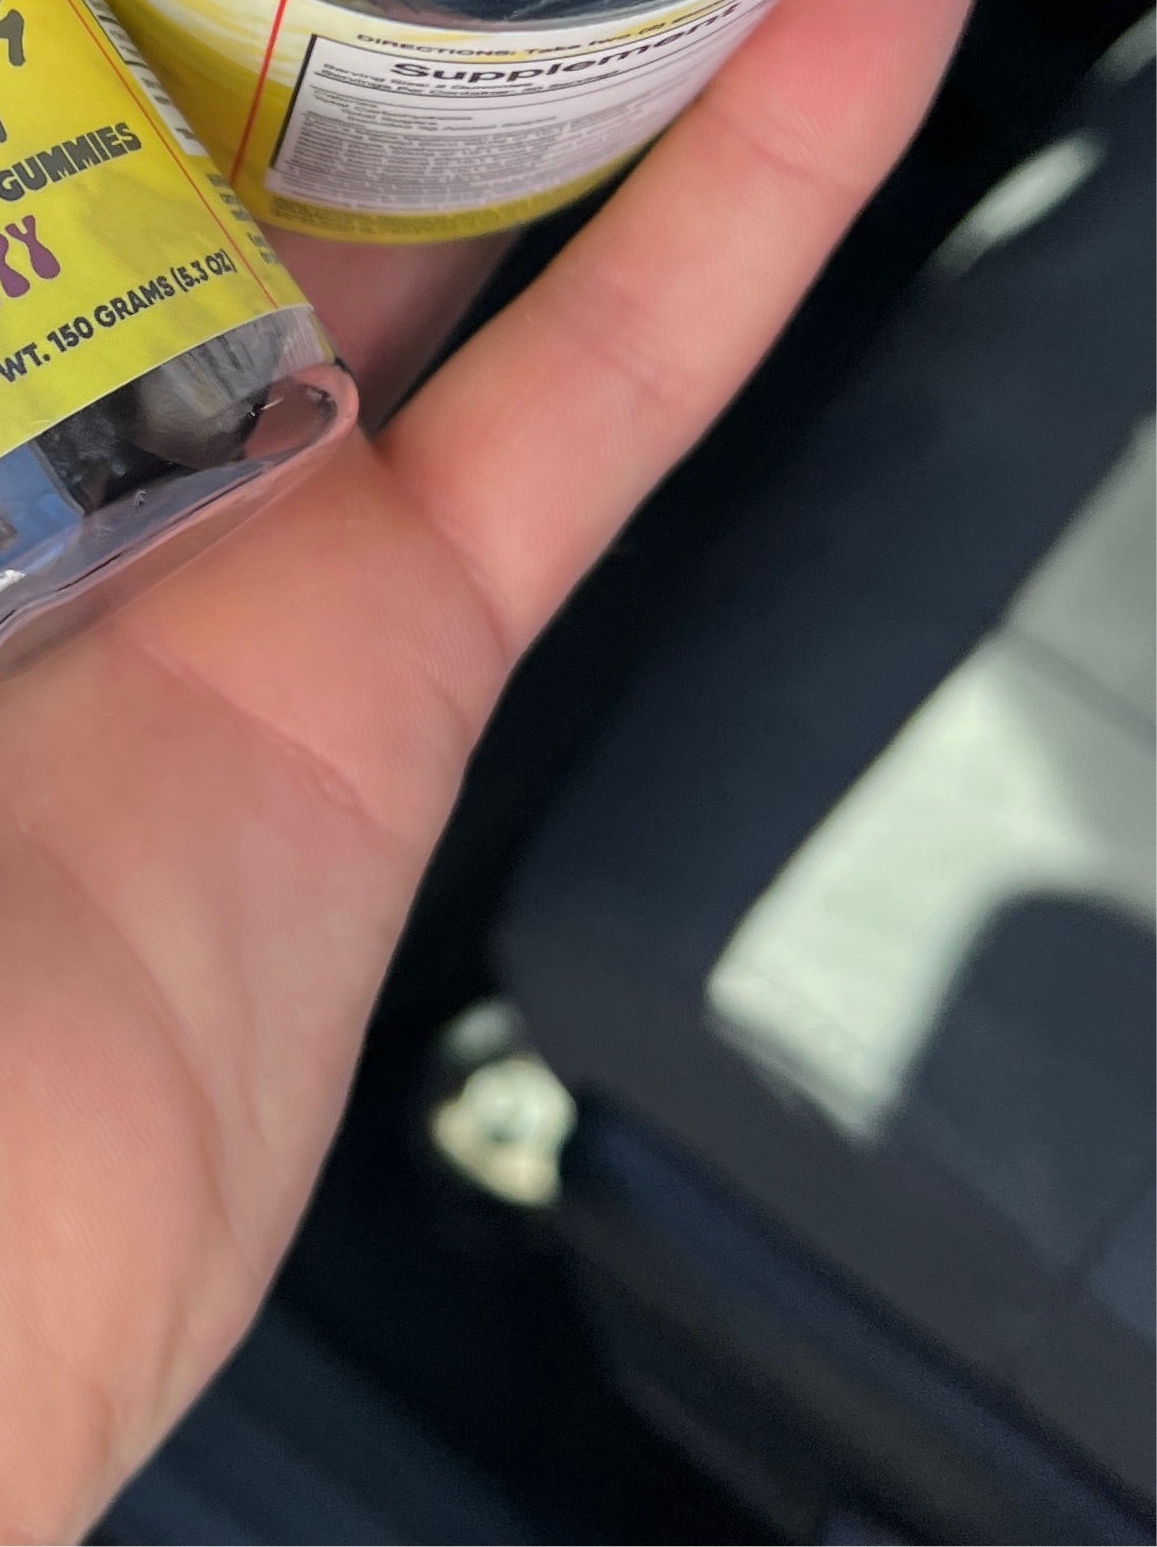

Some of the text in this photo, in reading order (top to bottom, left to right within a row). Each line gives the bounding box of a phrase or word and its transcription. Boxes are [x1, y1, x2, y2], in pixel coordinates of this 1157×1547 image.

[390, 1, 741, 84] Supplement
[47, 316, 95, 353] 150
[94, 274, 176, 328] GRAMS
[170, 259, 209, 293] (5.3
[206, 248, 238, 276] OZ)
